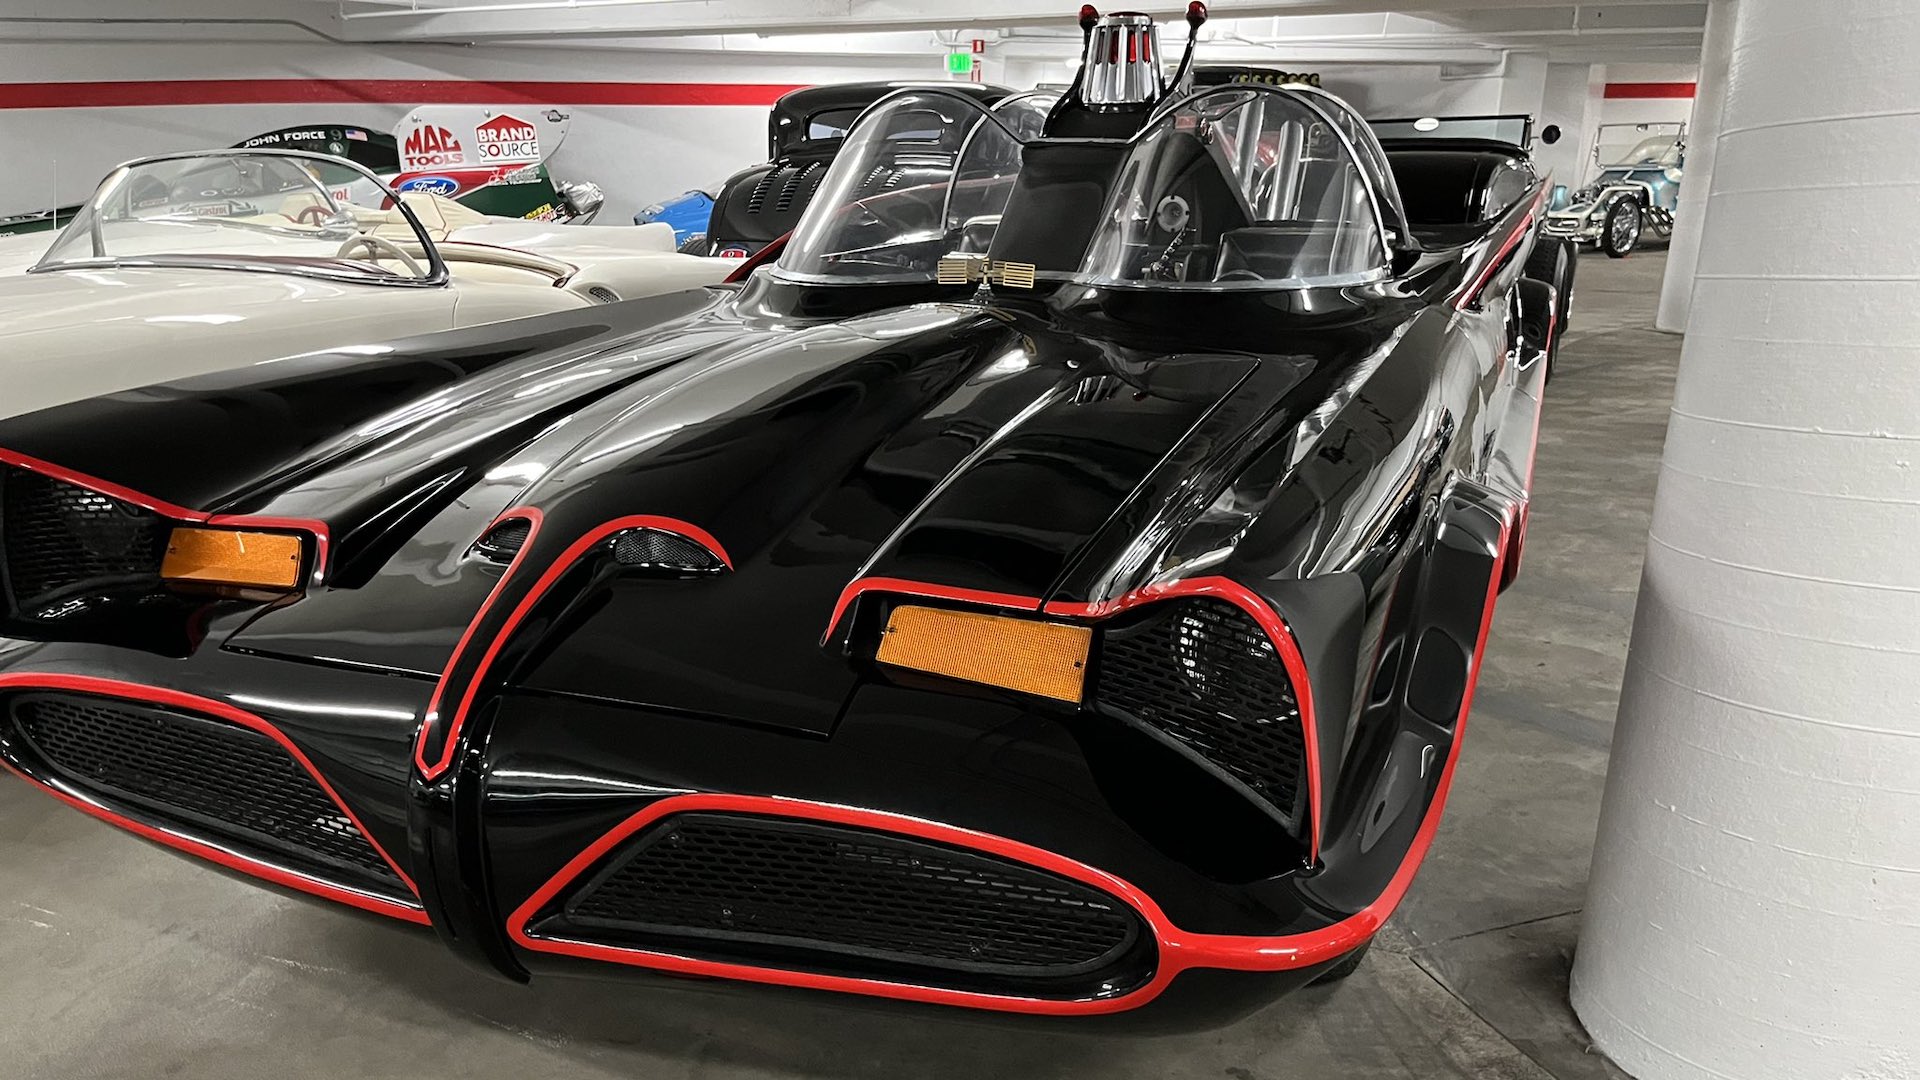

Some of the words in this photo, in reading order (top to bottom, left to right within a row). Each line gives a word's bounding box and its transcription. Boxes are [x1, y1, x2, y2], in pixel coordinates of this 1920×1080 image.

[244, 134, 280, 148] JOHN
[284, 131, 326, 141] FORCE
[404, 124, 462, 155] MAC
[477, 127, 535, 142] BRAND
[479, 141, 539, 158] SOURCE
[405, 153, 464, 166] TOOLS
[411, 180, 448, 195] Ford
